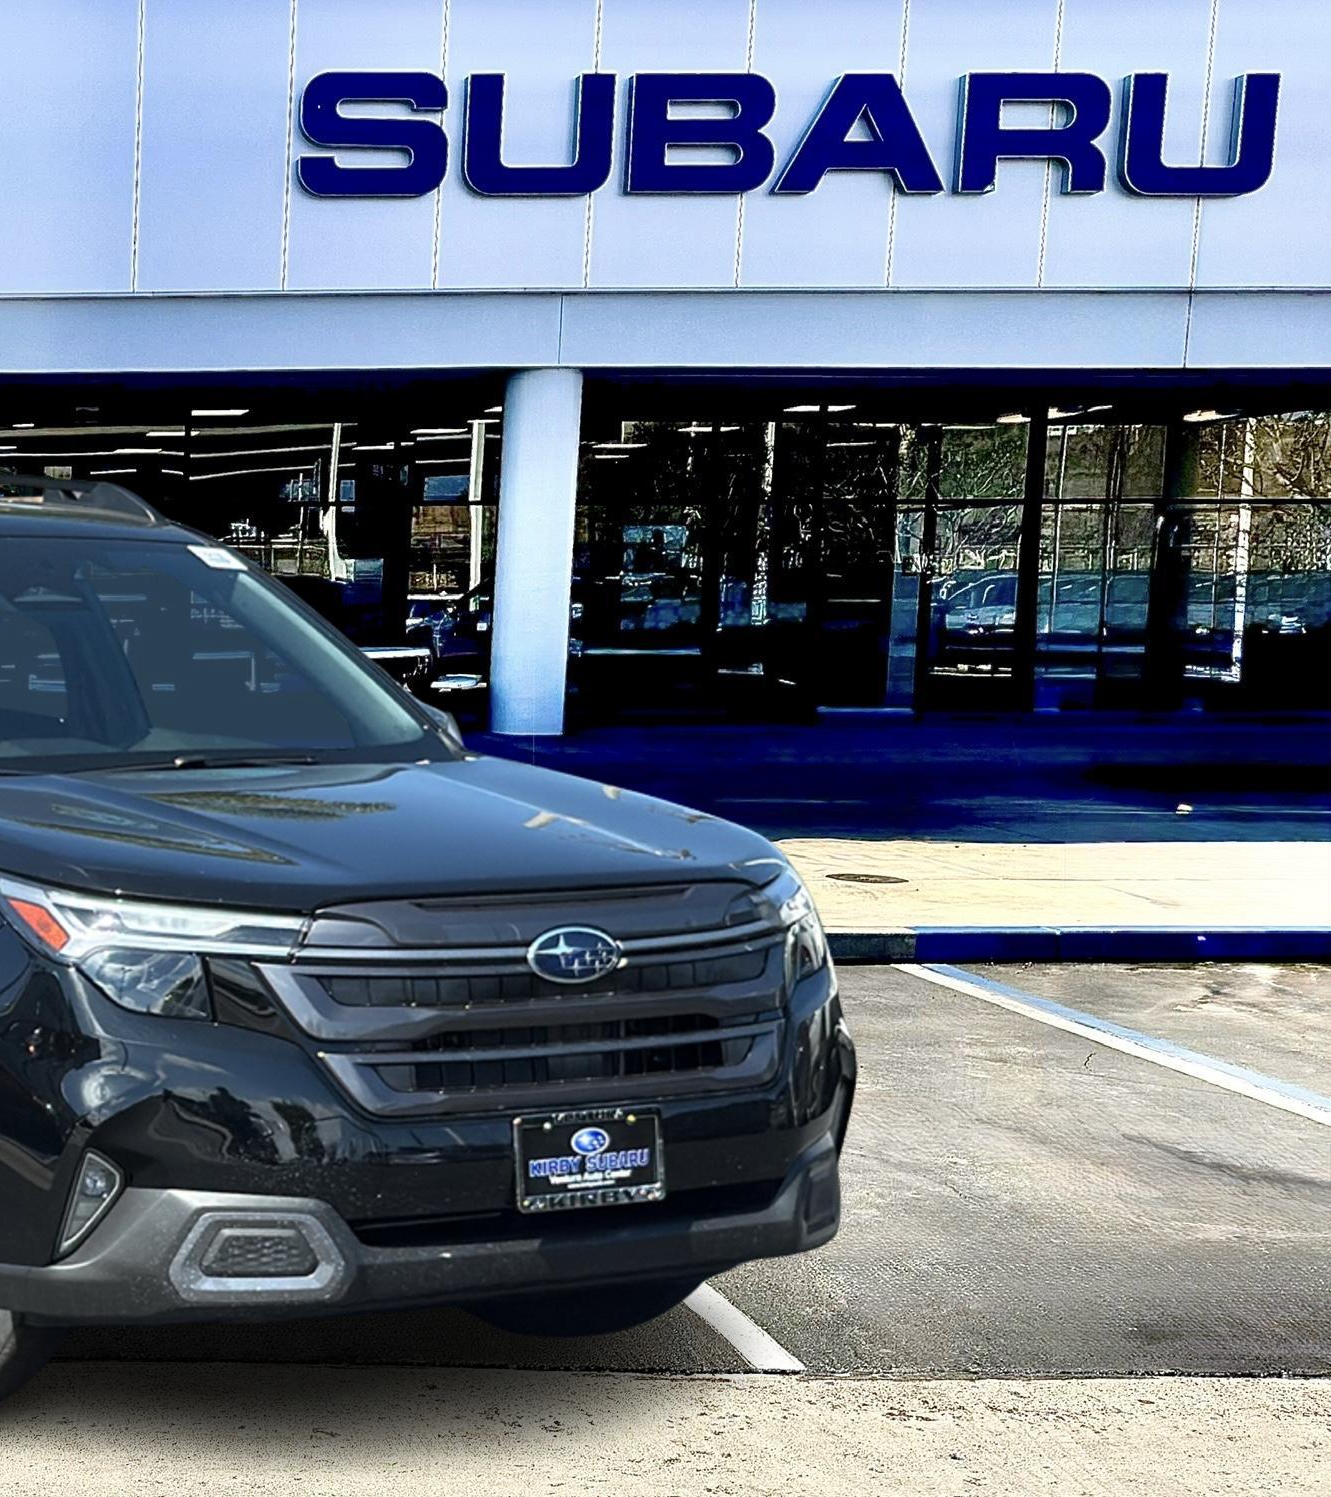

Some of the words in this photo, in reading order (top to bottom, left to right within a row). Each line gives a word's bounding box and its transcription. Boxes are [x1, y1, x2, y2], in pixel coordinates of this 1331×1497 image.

[296, 71, 1281, 200] SUBARU
[529, 1155, 582, 1178] KIRBY
[585, 1148, 650, 1172] SUBARU
[546, 1187, 637, 1209] KIRBY
